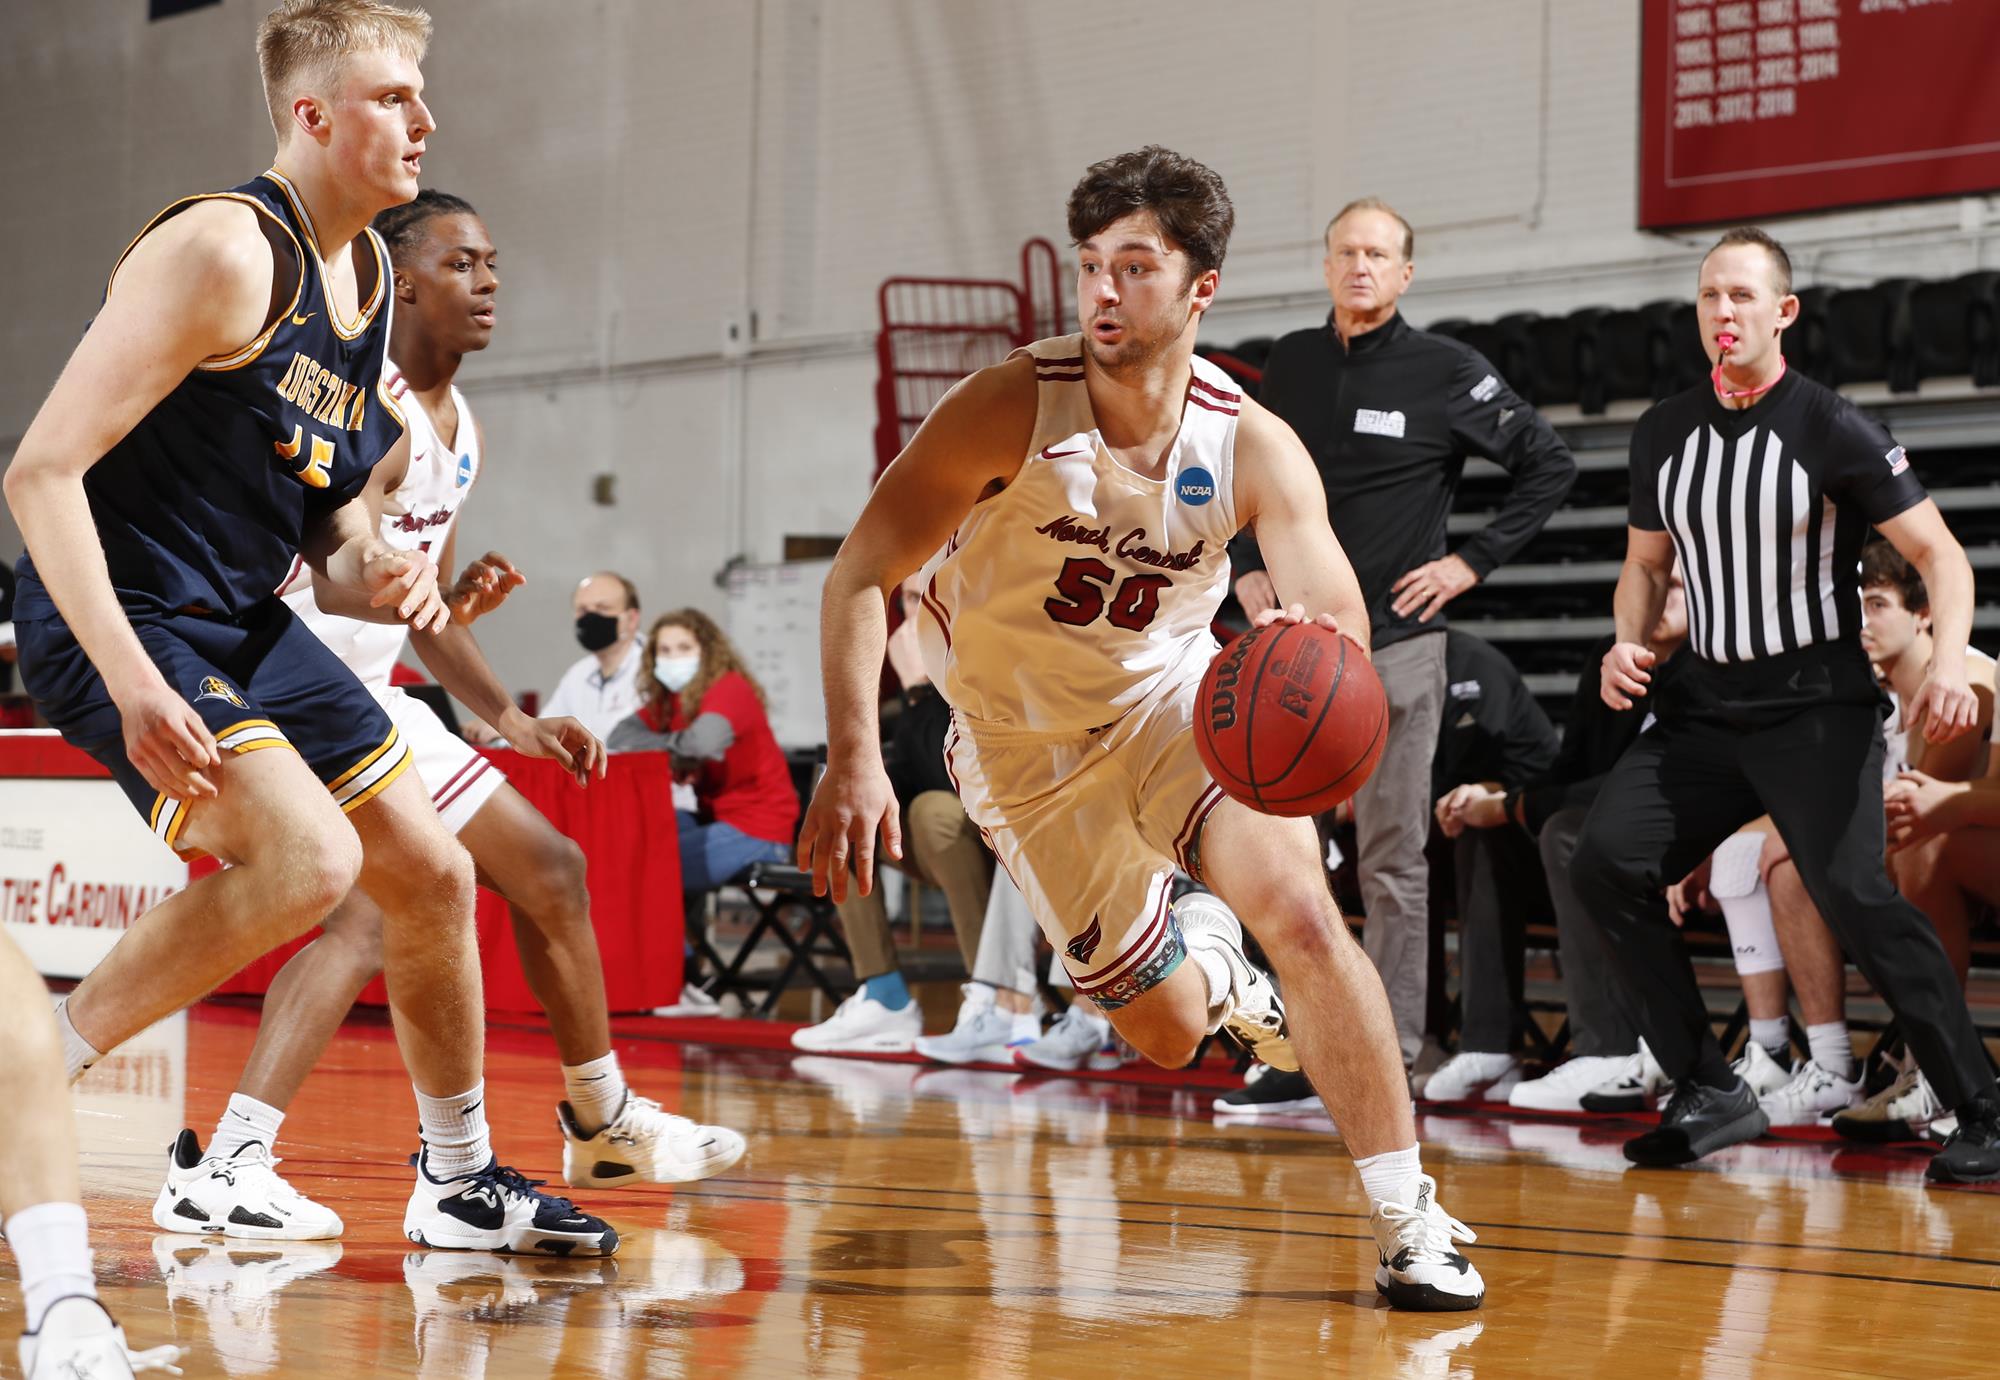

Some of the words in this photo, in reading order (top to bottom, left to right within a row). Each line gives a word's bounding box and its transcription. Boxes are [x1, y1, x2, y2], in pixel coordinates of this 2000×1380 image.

[1180, 484, 1213, 497] NCAA
[1043, 556, 1174, 633] 50
[3, 878, 41, 923] THE
[46, 861, 176, 930] CARDINA
